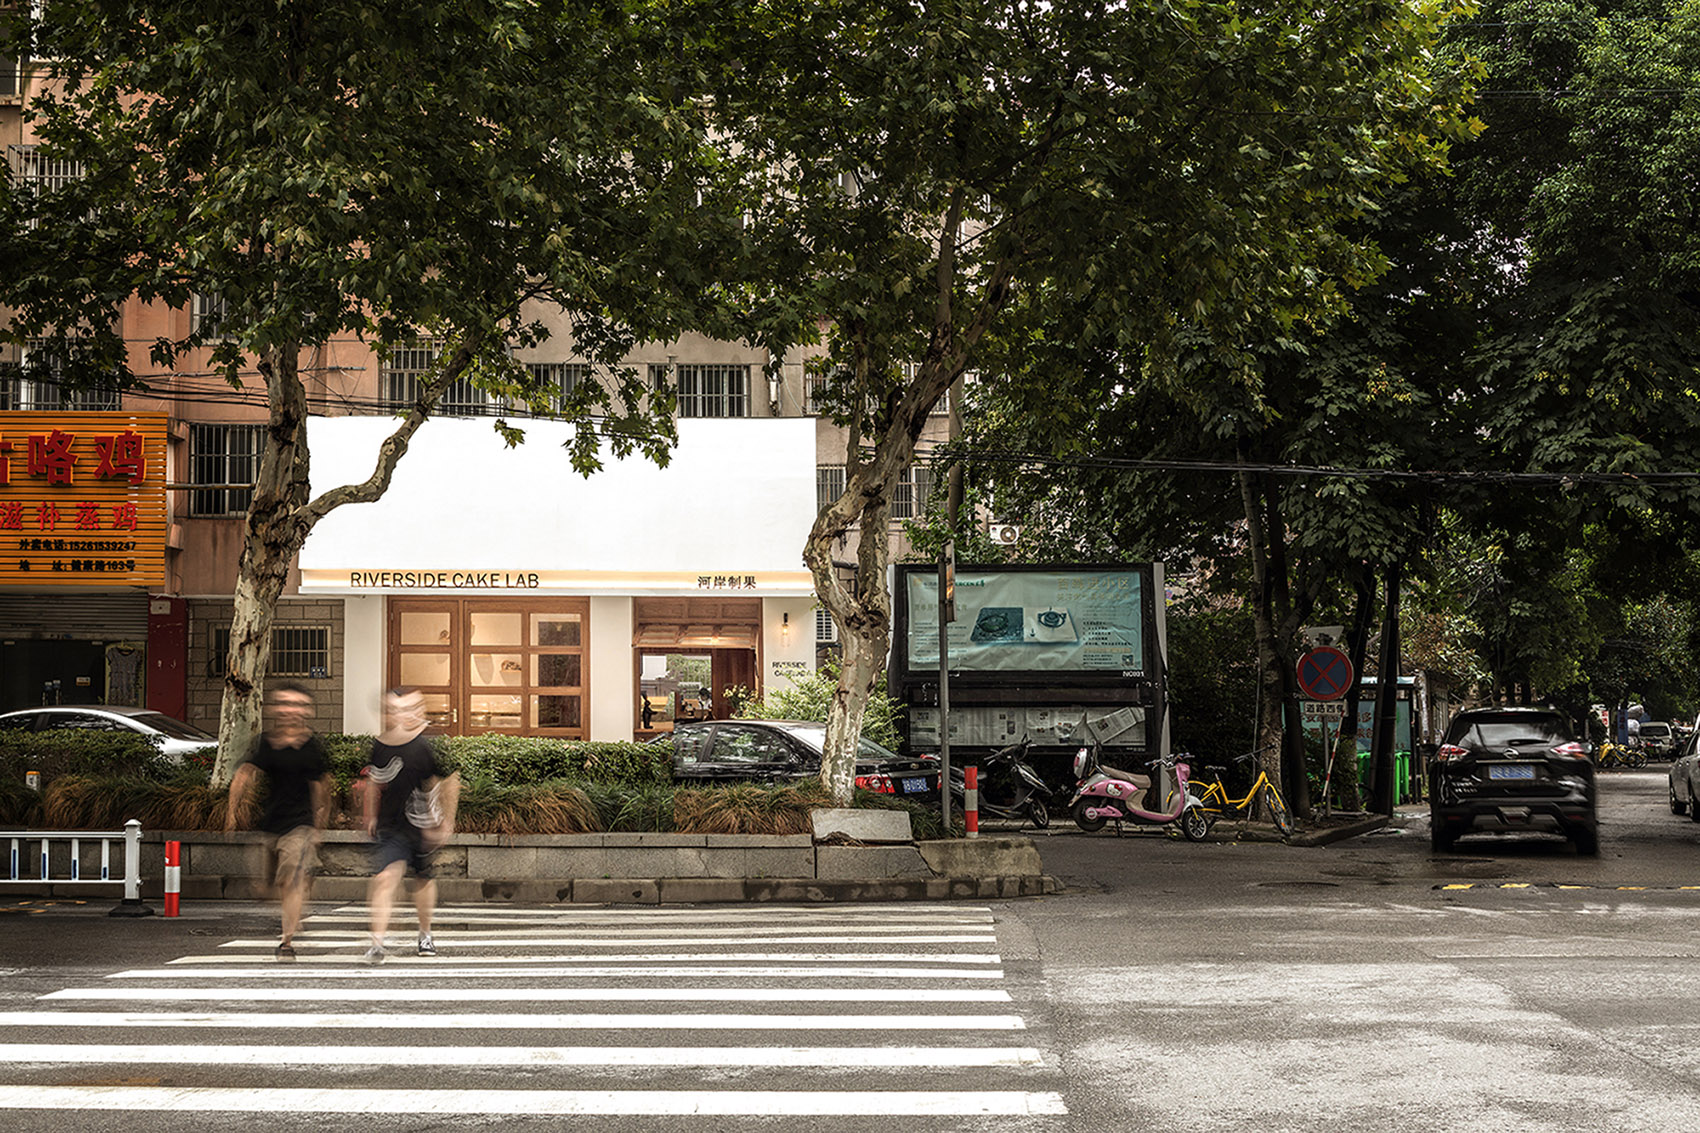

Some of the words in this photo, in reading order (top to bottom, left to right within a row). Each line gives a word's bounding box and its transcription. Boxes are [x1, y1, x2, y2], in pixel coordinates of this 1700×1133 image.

[0, 501, 137, 531] 滋补蒸鸡
[350, 572, 448, 588] RIVERSIDE
[452, 572, 500, 588] CAKE
[505, 573, 540, 589] LAB
[697, 575, 757, 590] 河岸制果
